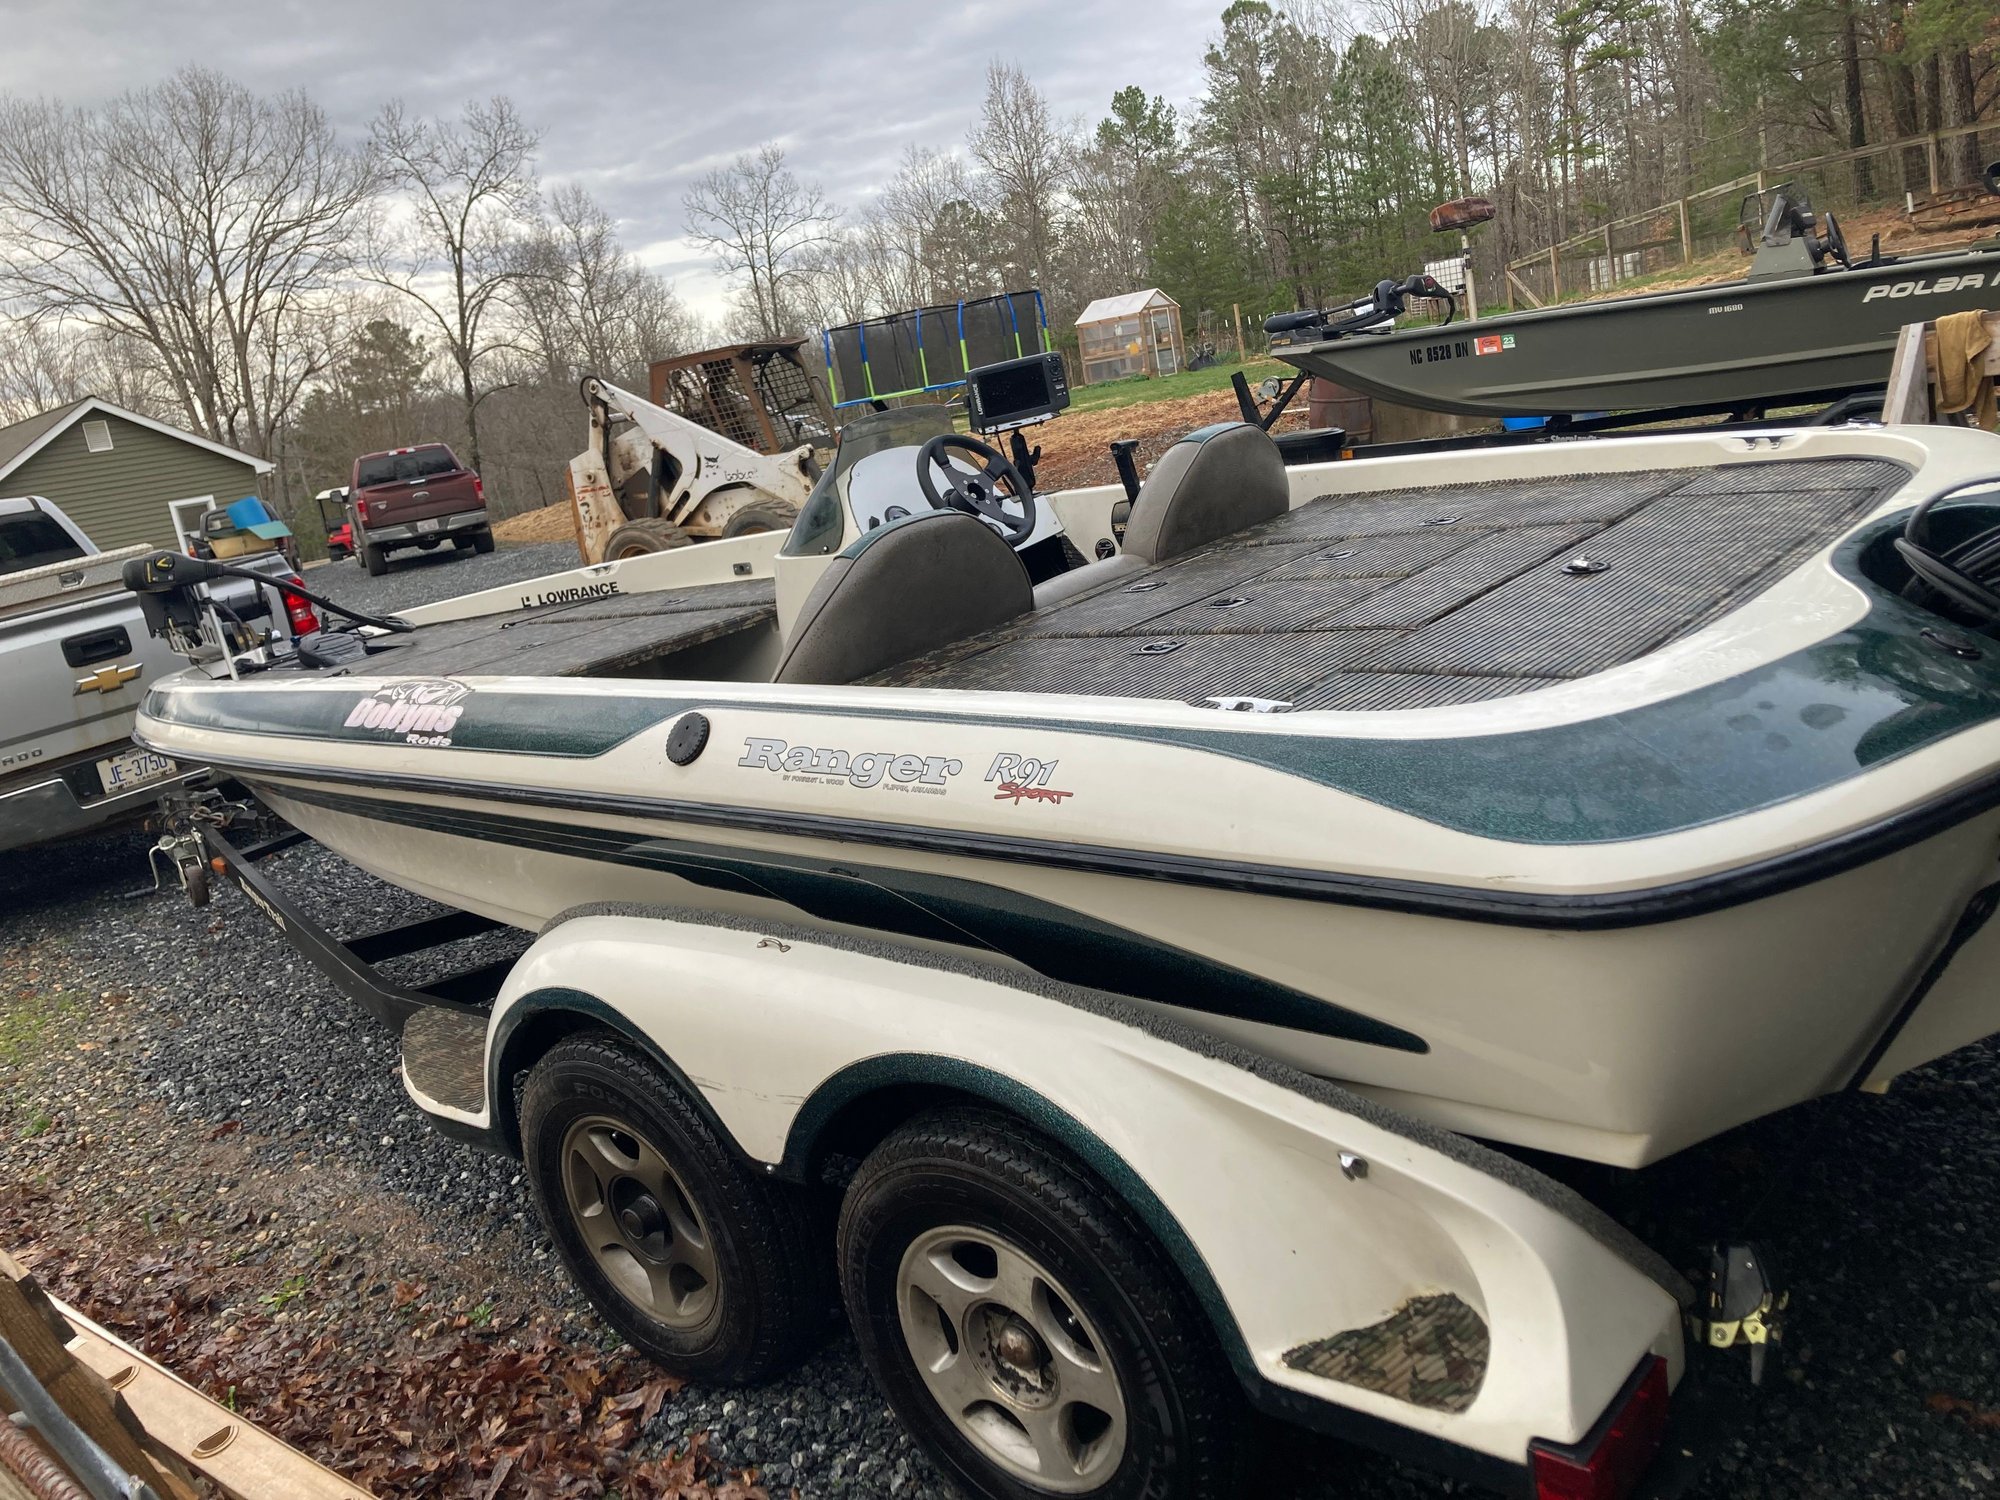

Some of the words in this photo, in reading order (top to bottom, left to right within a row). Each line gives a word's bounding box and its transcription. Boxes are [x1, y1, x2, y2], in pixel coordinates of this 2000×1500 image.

[1862, 273, 1985, 303] POLAR
[1724, 303, 1743, 313] 1680
[1503, 336, 1515, 345] 23
[1409, 349, 1423, 365] NC
[1426, 344, 1452, 363] 8528
[1455, 341, 1469, 358] DN
[972, 383, 984, 415] LOWRANCE
[537, 581, 620, 605] LOWRANCE
[343, 698, 464, 733] Dobyns
[405, 733, 452, 746] Rods
[738, 737, 963, 788] Ranger
[984, 752, 1060, 788] R91
[826, 778, 845, 786] WOOD
